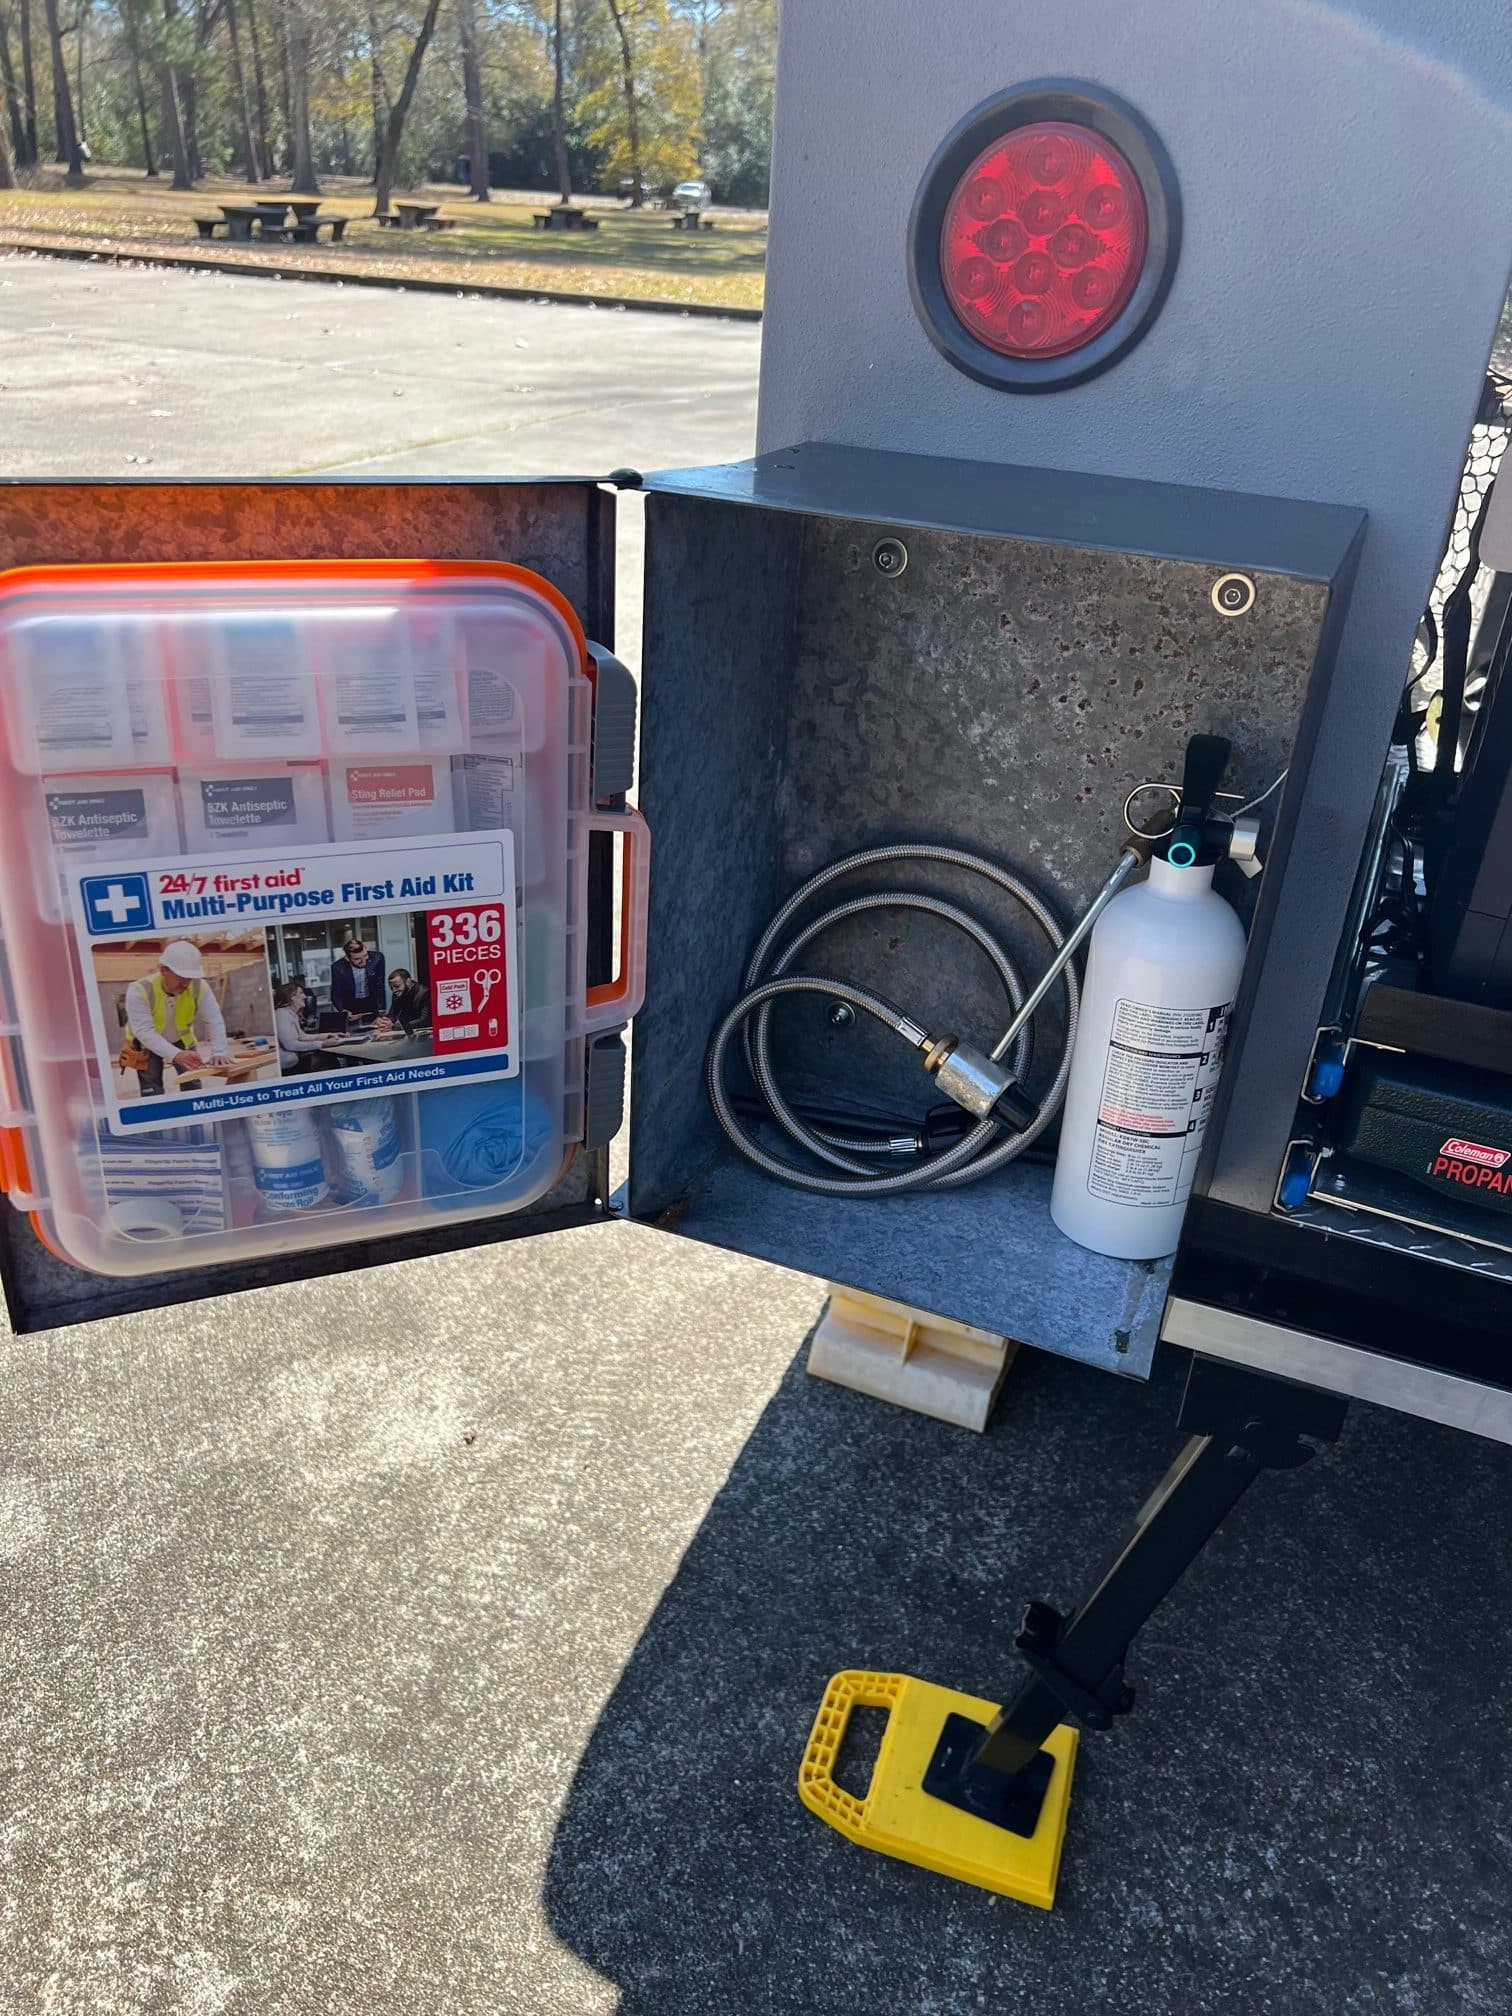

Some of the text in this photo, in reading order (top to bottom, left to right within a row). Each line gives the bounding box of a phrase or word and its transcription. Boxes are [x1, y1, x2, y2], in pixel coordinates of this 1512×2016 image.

[352, 787, 426, 800] Sting Relief Pad
[231, 800, 288, 813] Antiseptic
[78, 812, 138, 826] Antiseptic
[208, 814, 262, 825] Towelette
[54, 827, 110, 841] Towelette
[159, 873, 208, 896] 24/7
[213, 874, 260, 893] first
[162, 873, 474, 920] Multi-Purpose First Aid Kit
[431, 910, 501, 948] 336
[433, 944, 501, 965] PIECES
[1201, 1055, 1208, 1063] 2
[192, 1067, 446, 1111] Multi-Use to Treat All Your First Aid Needs
[1448, 1142, 1494, 1161] Coleman
